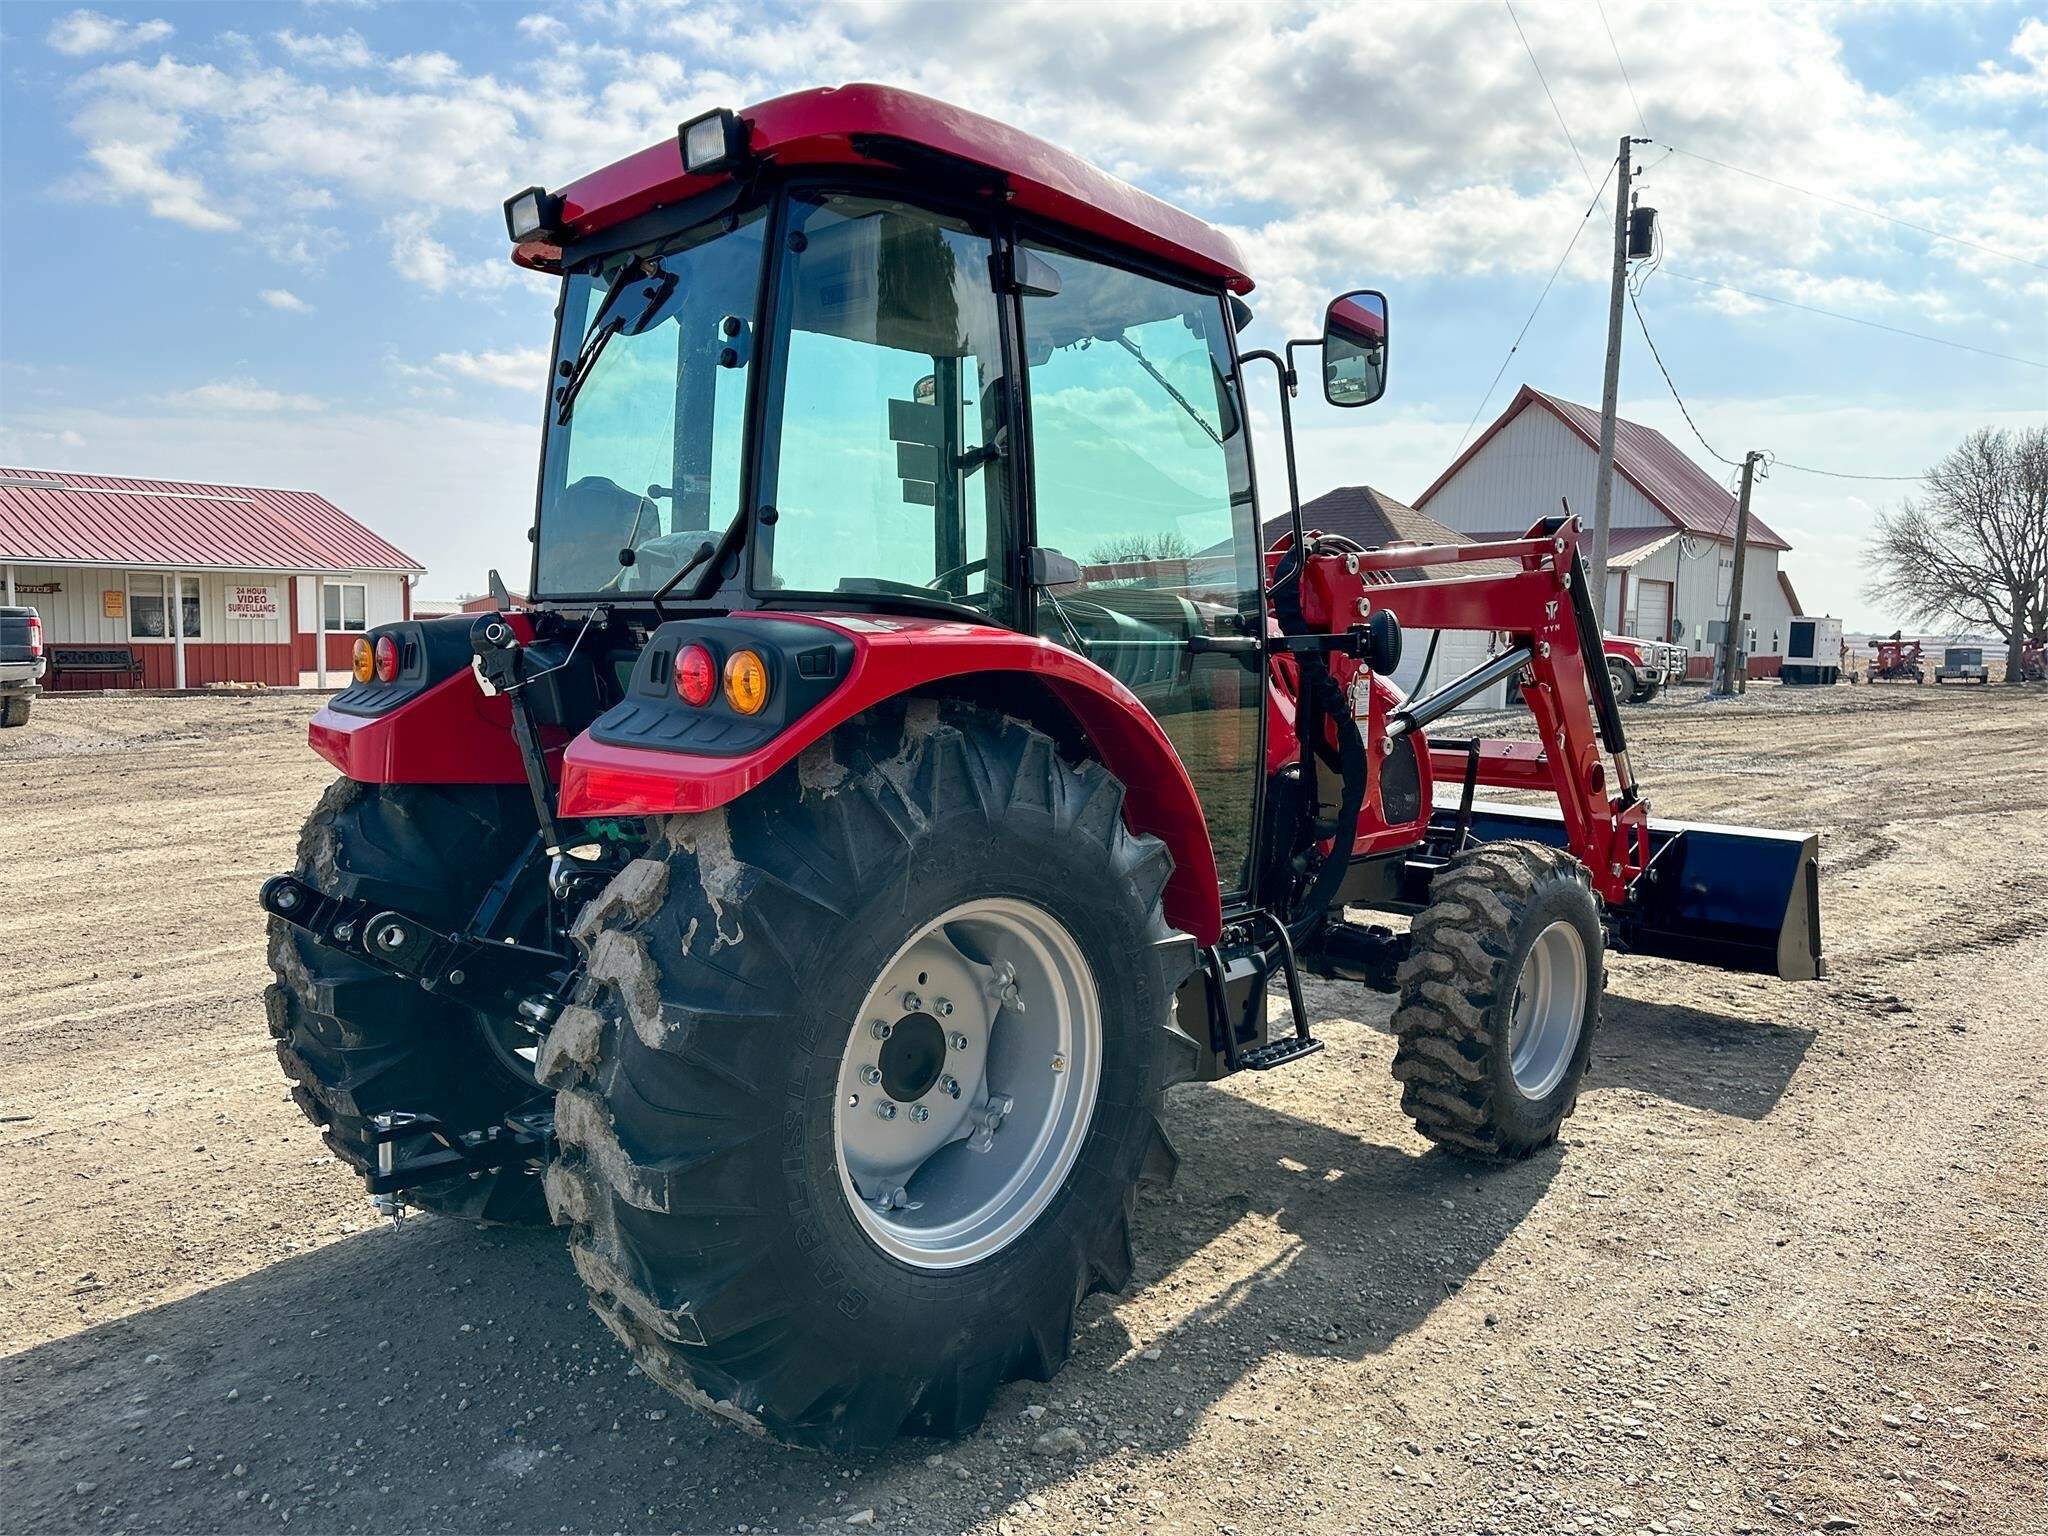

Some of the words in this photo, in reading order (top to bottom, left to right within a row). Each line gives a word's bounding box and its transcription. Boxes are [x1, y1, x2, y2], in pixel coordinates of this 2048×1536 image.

[236, 587, 245, 595] 24
[246, 587, 267, 595] HOUR
[237, 595, 267, 604] VIDEO
[228, 603, 276, 613] SURVEILLANCE
[1543, 623, 1560, 633] TYM
[56, 651, 129, 664] CYCLONES
[782, 1013, 870, 1321] CARLISLE
